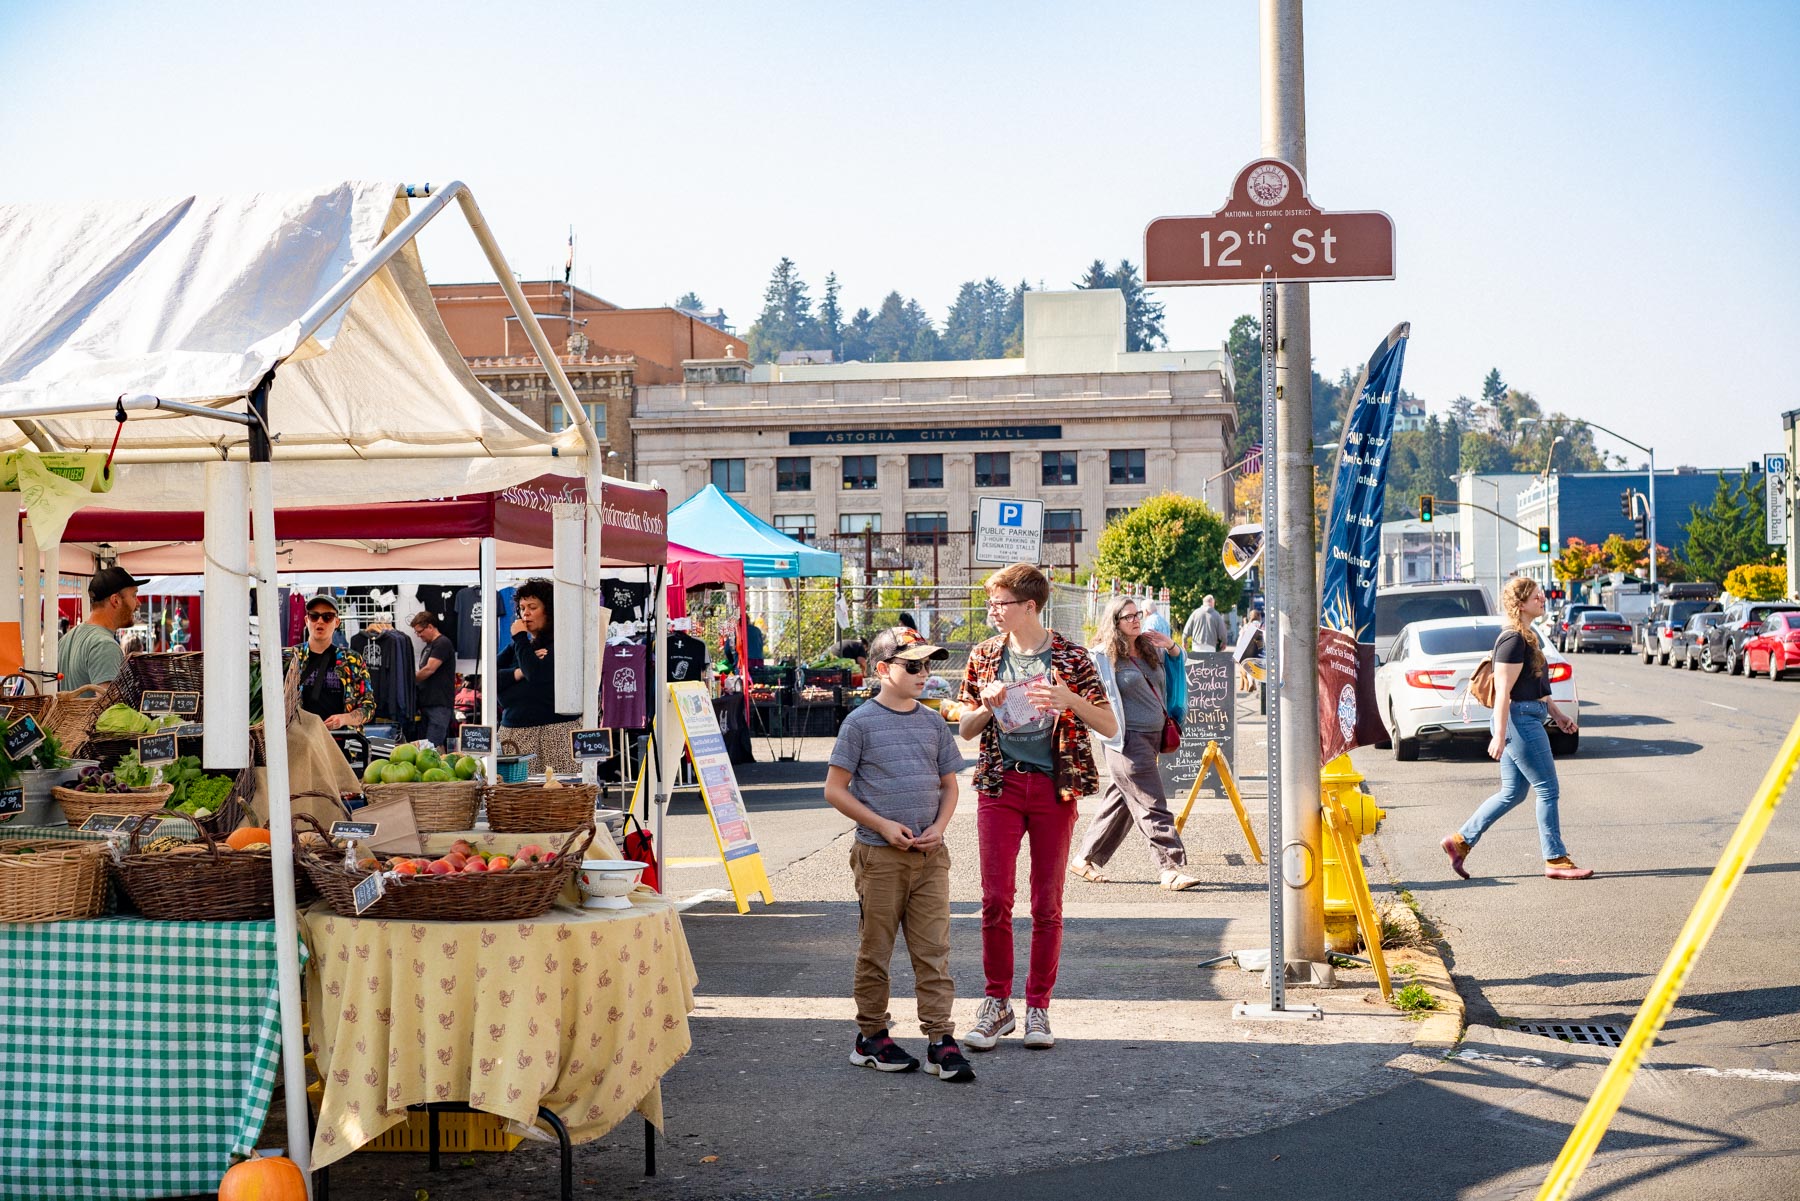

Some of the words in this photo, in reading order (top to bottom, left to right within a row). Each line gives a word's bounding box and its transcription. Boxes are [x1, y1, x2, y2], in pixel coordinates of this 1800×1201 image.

[1201, 230, 1267, 267] 12th
[1291, 228, 1337, 265] St
[826, 432, 896, 442] ASTORIA
[920, 430, 957, 440] CITY
[980, 429, 1025, 438] HALL
[1003, 505, 1018, 524] P
[643, 513, 663, 535] Booth
[980, 527, 1006, 535] PUBLIC
[1008, 529, 1039, 537] PARKING
[1771, 519, 1782, 541] Bank
[1188, 662, 1229, 679] Astoria
[1188, 676, 1228, 700] Sunday
[1187, 691, 1221, 709] arket
[464, 729, 482, 737] Green
